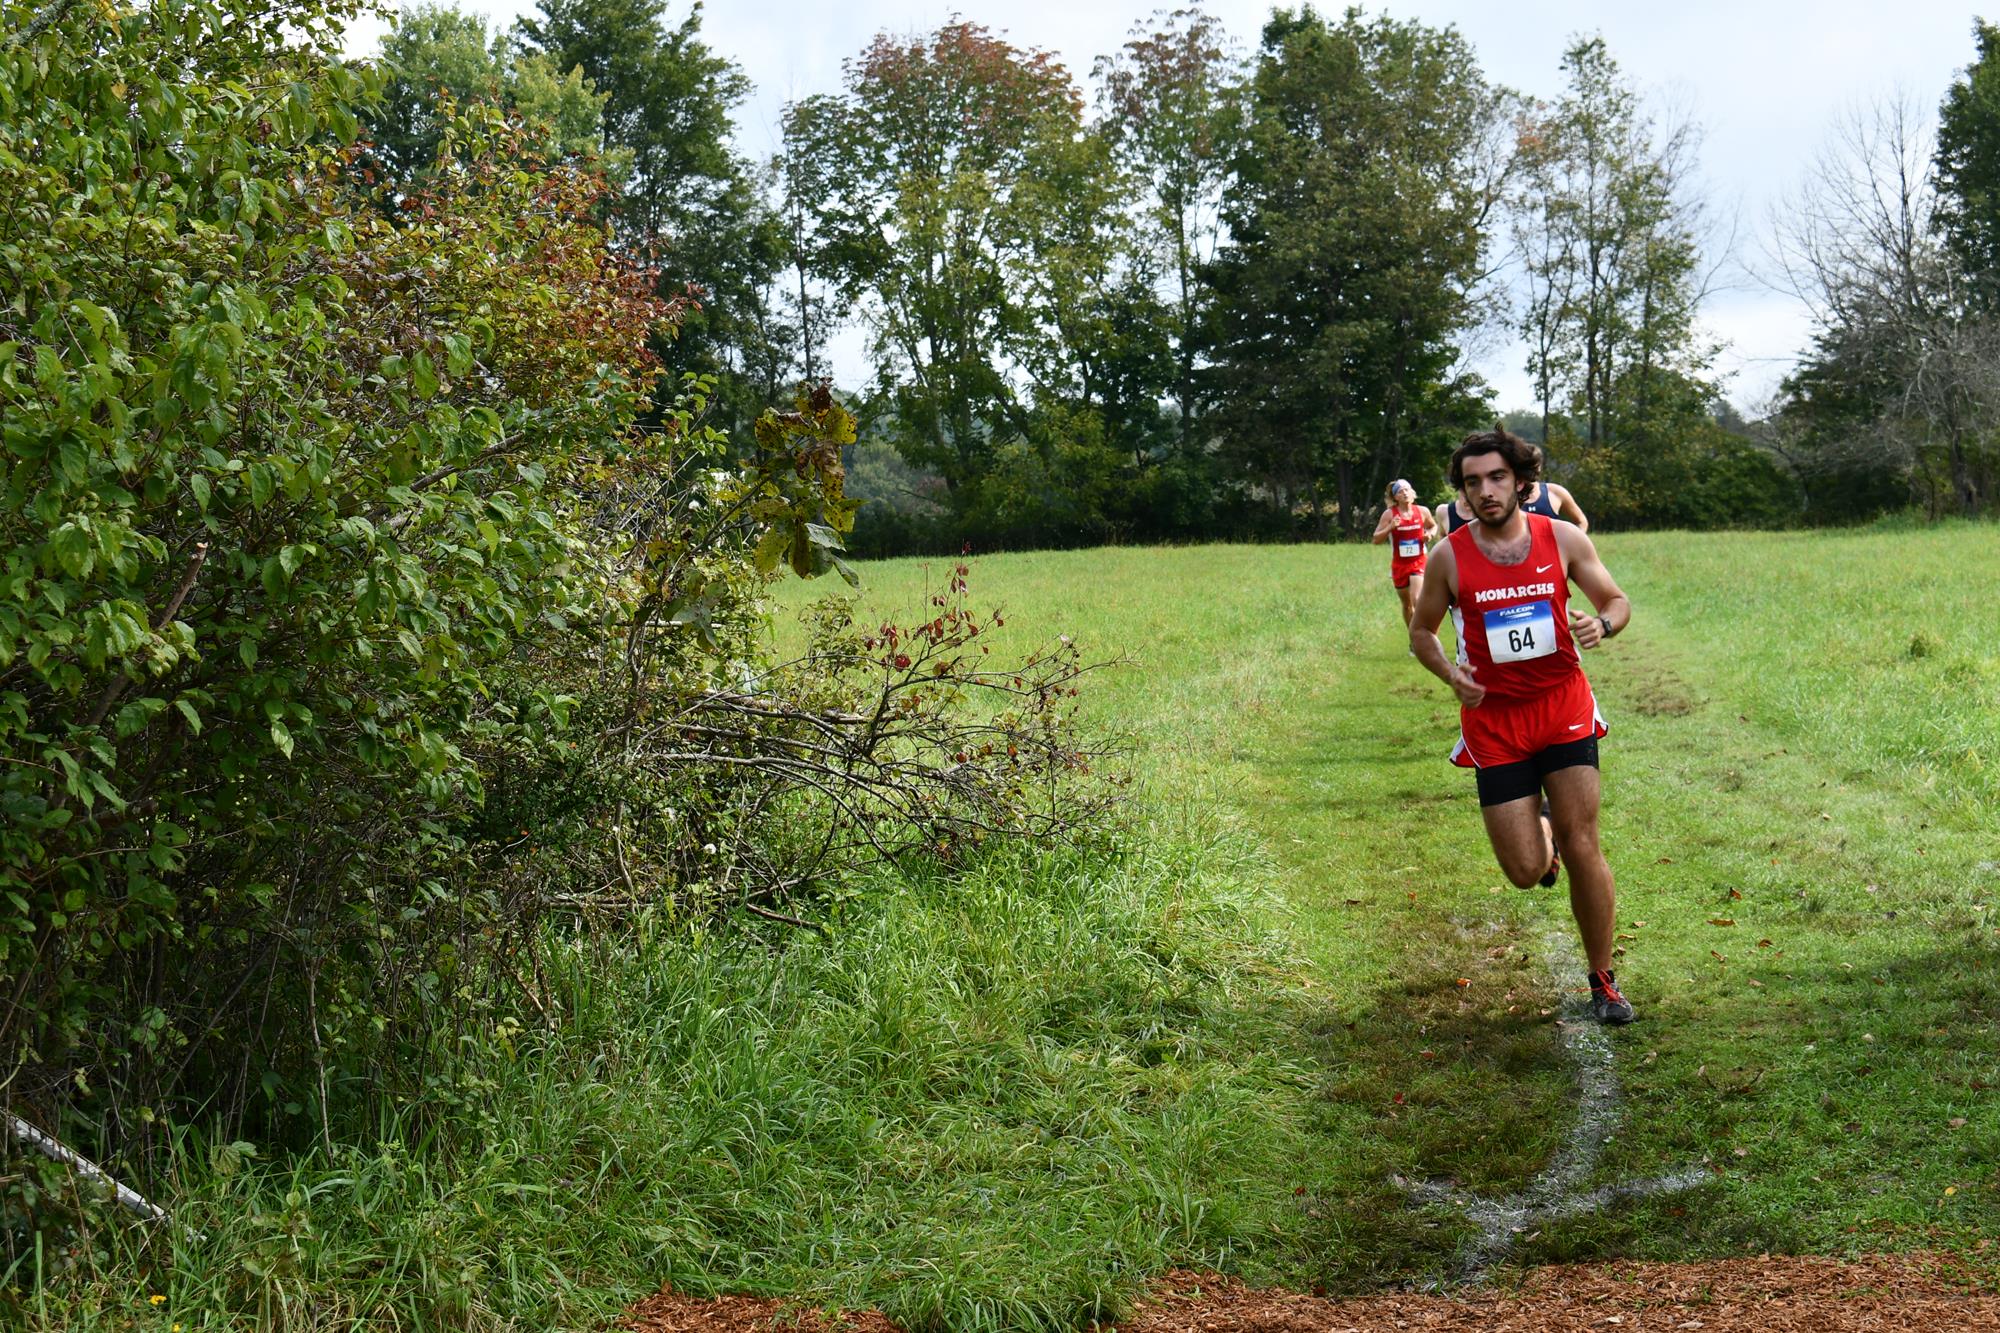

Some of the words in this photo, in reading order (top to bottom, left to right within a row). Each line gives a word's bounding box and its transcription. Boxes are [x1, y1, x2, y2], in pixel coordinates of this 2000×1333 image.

[1475, 583, 1555, 603] MONARCHS
[1499, 605, 1535, 616] FALCON
[1508, 626, 1535, 653] 64
